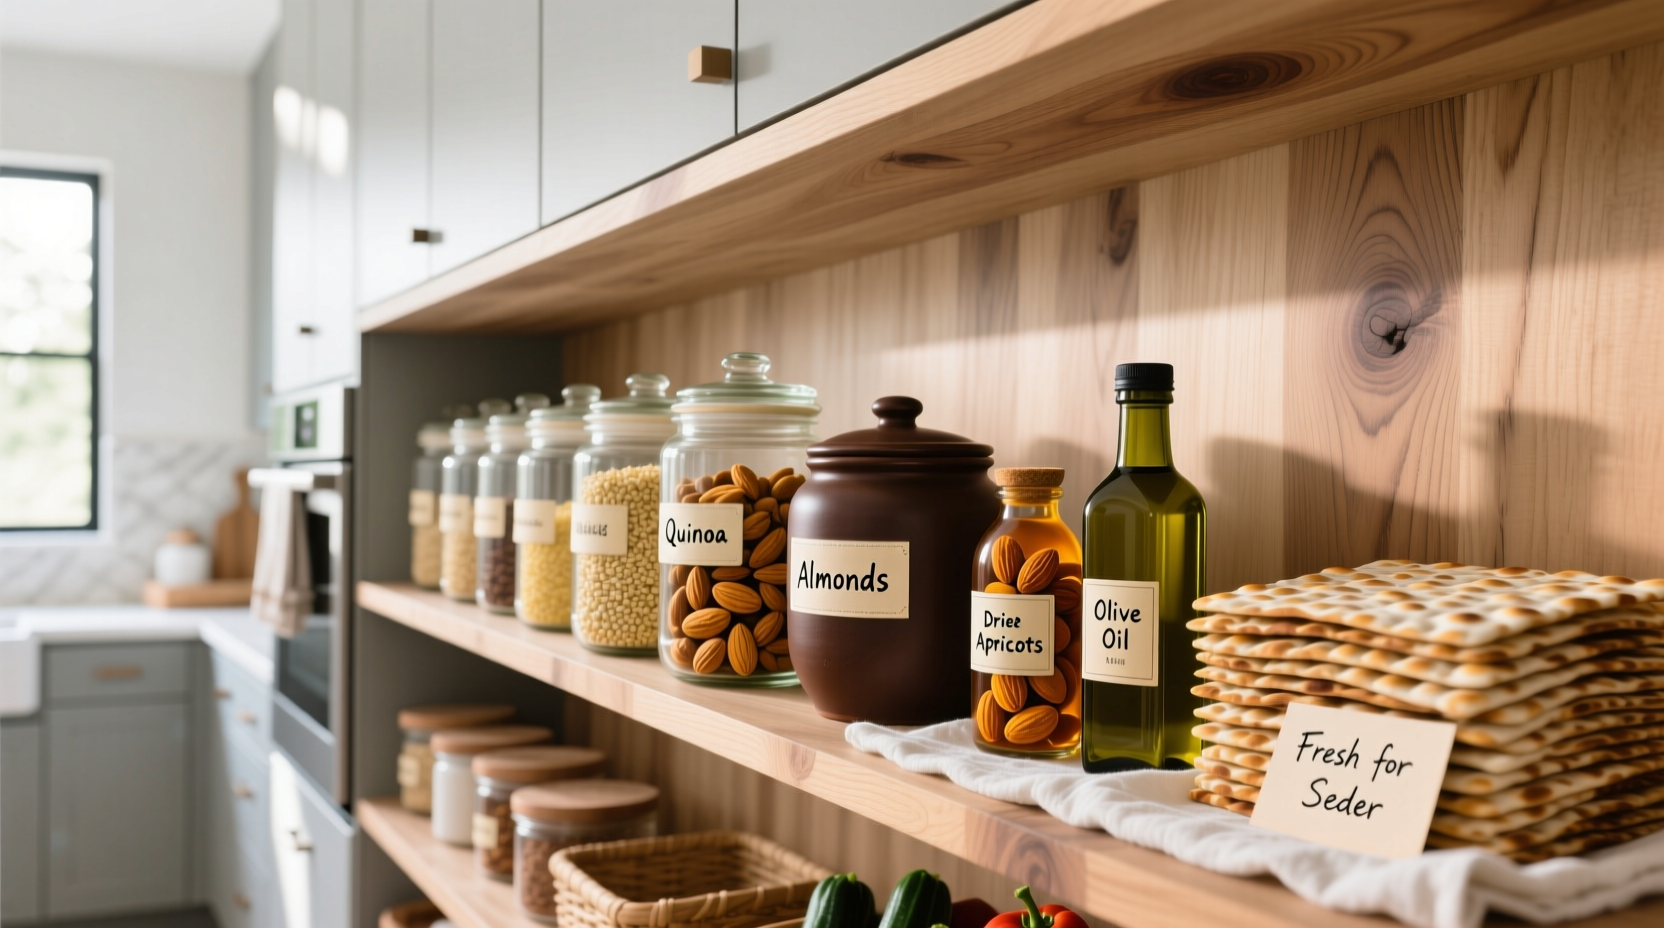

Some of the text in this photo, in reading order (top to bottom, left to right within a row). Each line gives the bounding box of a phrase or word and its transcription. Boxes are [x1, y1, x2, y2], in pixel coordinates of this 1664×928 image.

[665, 518, 728, 547] Quinoa
[797, 560, 889, 593] Almonds
[1094, 599, 1142, 623] Olive
[976, 632, 1044, 657] Apricots
[1102, 628, 1129, 650] Oil
[1296, 732, 1413, 782] Fresh for
[1301, 777, 1384, 820] Seder
